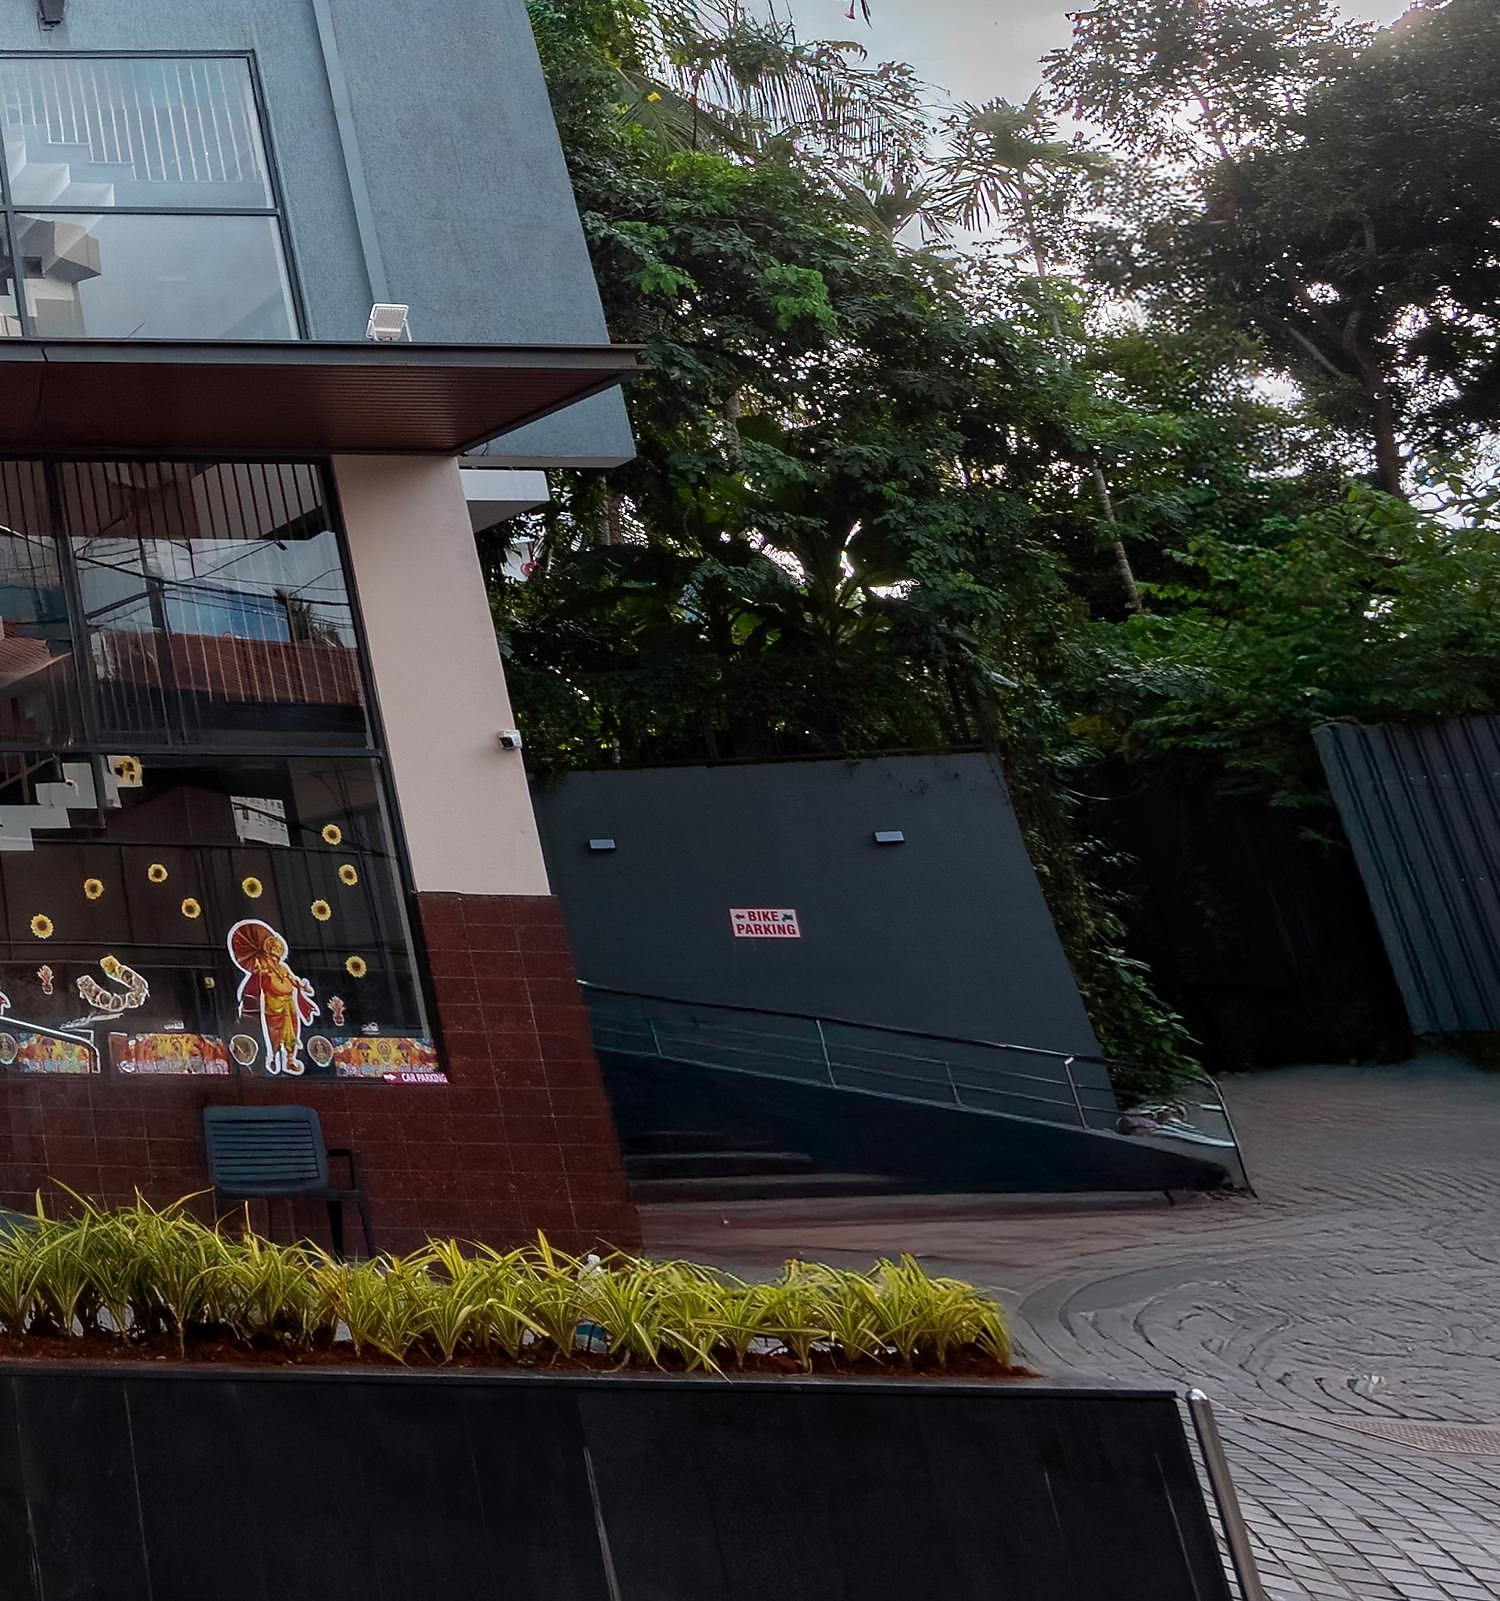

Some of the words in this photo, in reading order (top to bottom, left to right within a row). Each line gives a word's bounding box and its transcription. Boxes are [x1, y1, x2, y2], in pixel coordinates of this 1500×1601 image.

[747, 910, 779, 922] BIKE
[736, 923, 797, 935] PARKING
[401, 1072, 417, 1083] CAR
